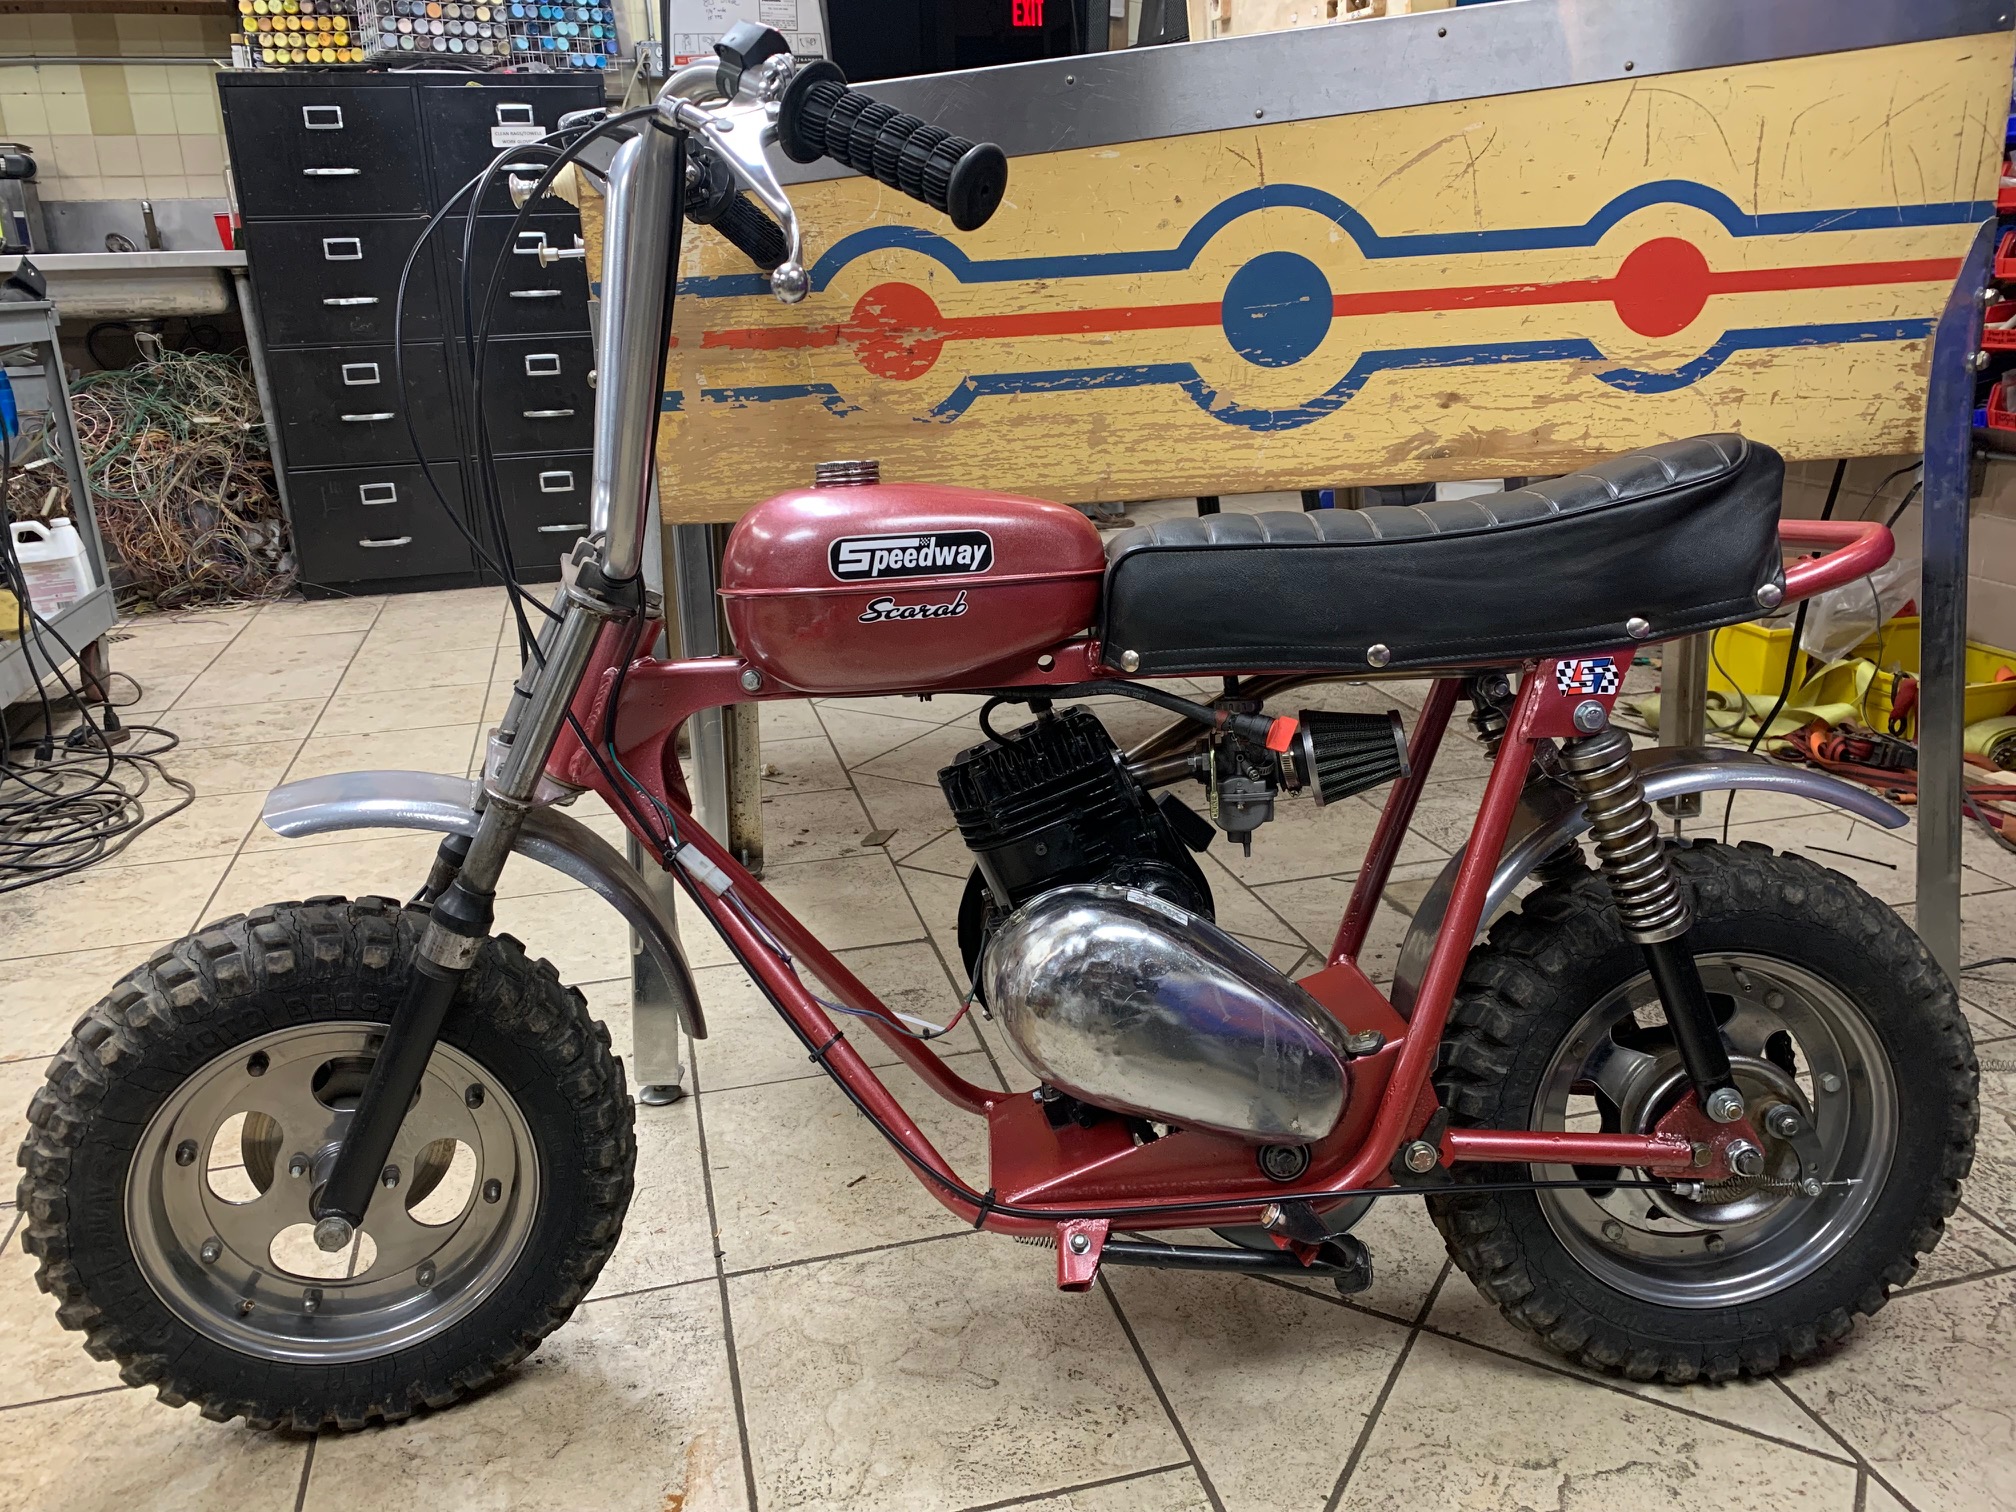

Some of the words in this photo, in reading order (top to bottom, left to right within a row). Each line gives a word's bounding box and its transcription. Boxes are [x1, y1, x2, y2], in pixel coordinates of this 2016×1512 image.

[1012, 0, 1044, 26] EXIT
[838, 537, 987, 577] Speedway
[858, 590, 968, 623] Scarab
